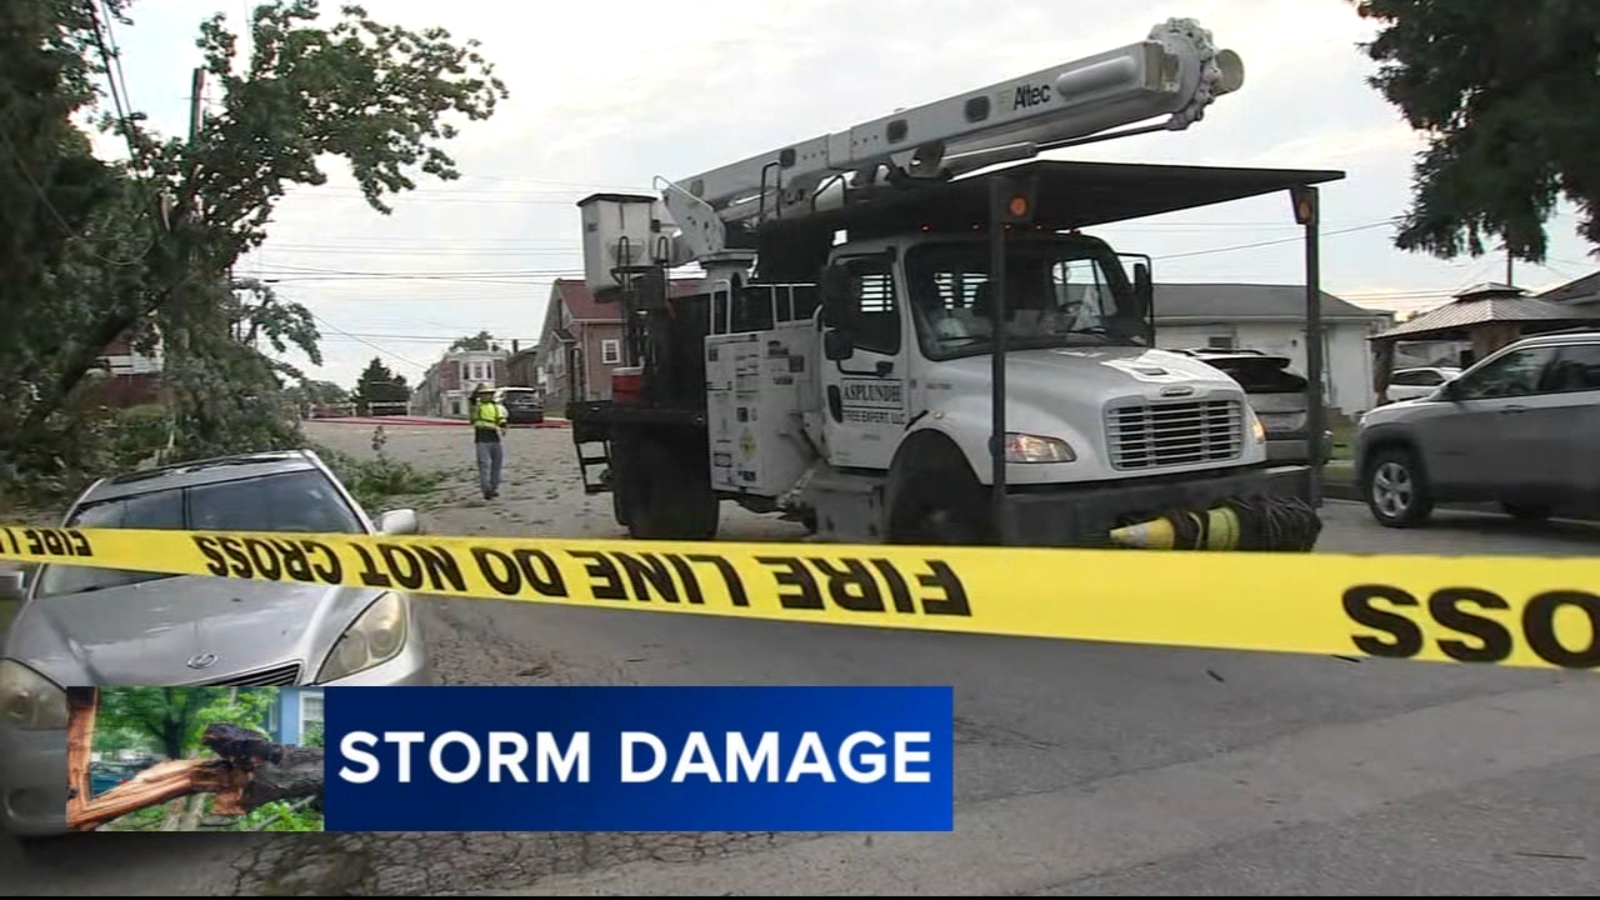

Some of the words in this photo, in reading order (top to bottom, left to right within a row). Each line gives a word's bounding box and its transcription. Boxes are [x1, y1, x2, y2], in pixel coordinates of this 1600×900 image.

[1013, 84, 1051, 111] Altec
[24, 528, 94, 557] FIRE
[193, 535, 343, 585] CROSS
[350, 542, 468, 592] NOT
[471, 547, 569, 598] DO
[567, 550, 750, 607] LINE
[755, 556, 972, 617] FIRE
